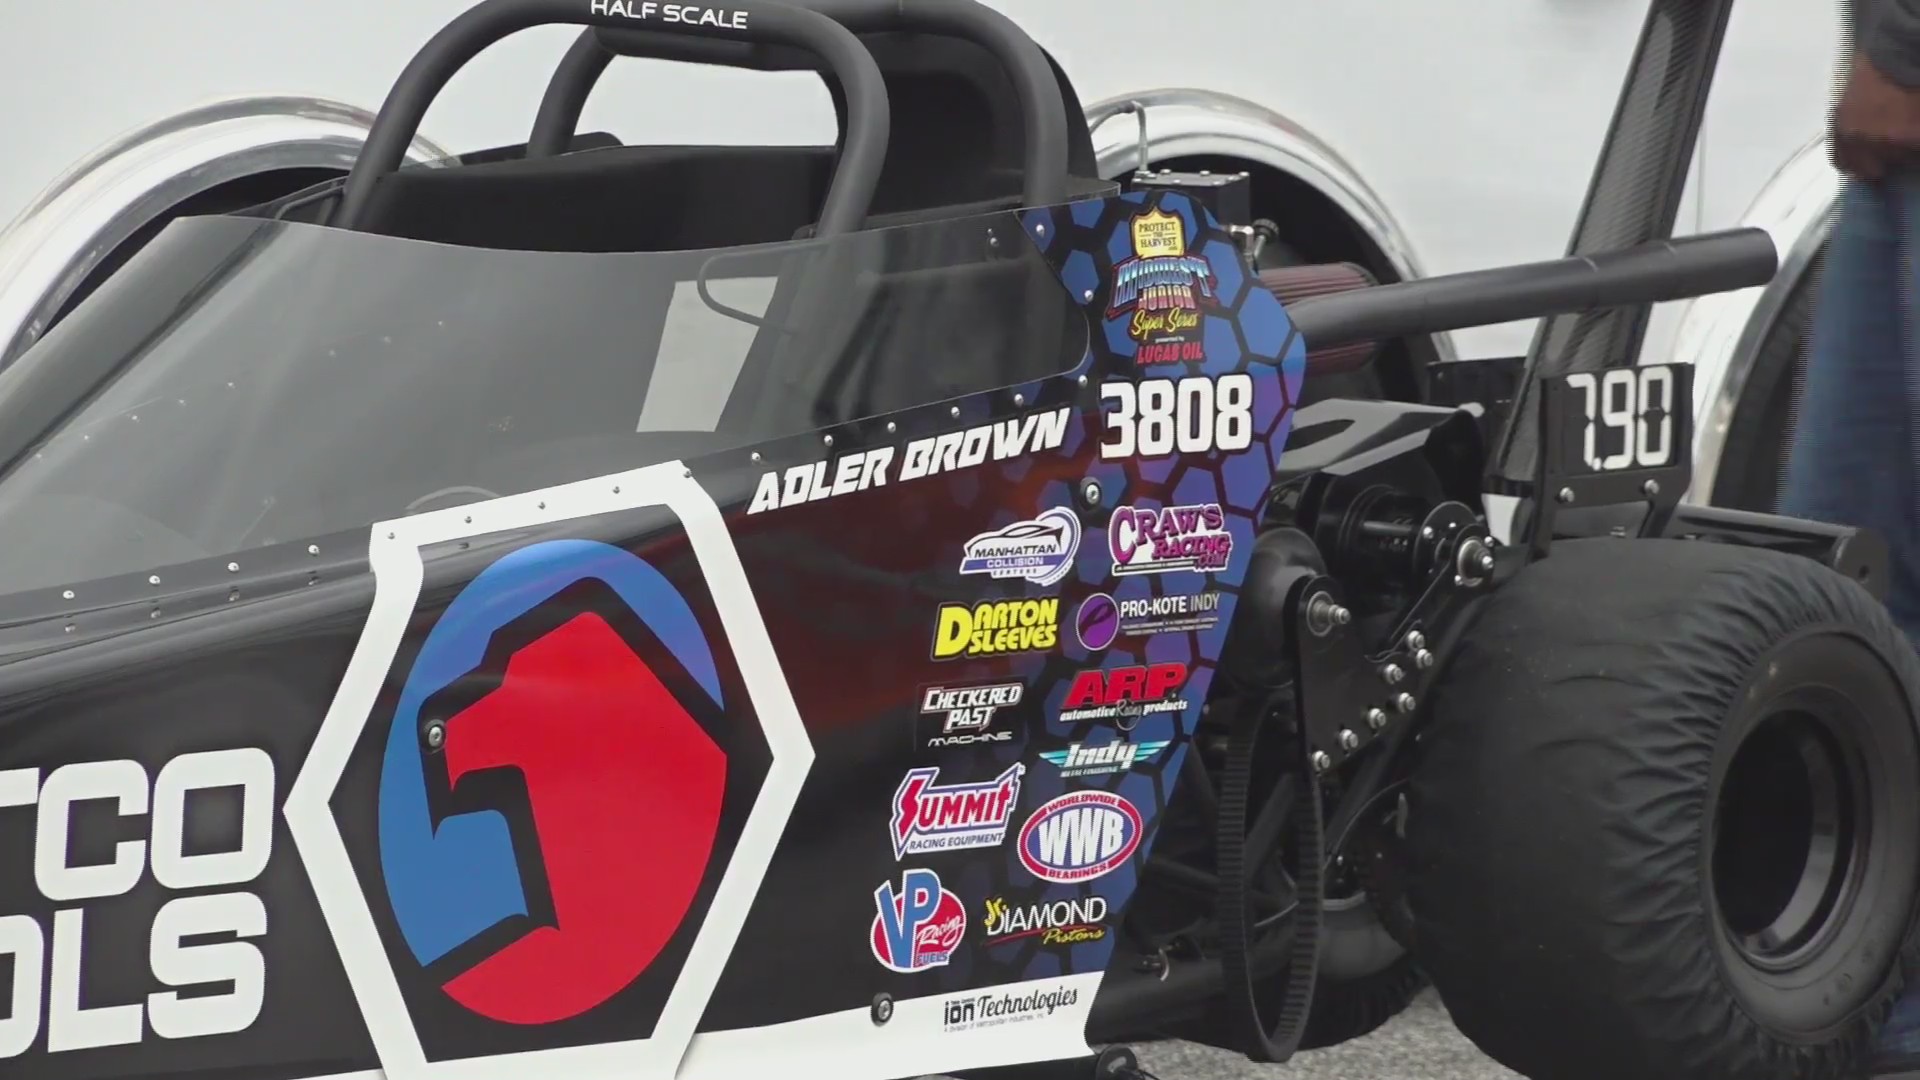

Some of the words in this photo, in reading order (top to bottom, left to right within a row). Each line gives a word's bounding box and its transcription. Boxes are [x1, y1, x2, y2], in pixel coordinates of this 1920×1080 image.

[591, 0, 657, 19] HALF
[663, 5, 748, 29] SCALE
[1138, 221, 1176, 233] PROTECT
[1140, 237, 1177, 248] HARVEST
[1114, 257, 1210, 307] MIDWEST
[1138, 285, 1196, 310] JUNIOR
[1131, 309, 1164, 340] Super
[1166, 307, 1198, 333] Series
[1137, 344, 1180, 364] LUCAS
[1182, 342, 1203, 360] OIL
[1100, 373, 1253, 458] 3808
[747, 445, 894, 515] ADLER
[899, 407, 1071, 482] BROWN
[1110, 506, 1222, 565] CRAW'S
[1152, 533, 1231, 560] RACING
[975, 544, 1057, 558] MANHATTAN
[986, 556, 1044, 568] COLLISION
[1120, 596, 1187, 618] PRO-KOTE
[1190, 593, 1220, 612] INDY
[934, 599, 1059, 656] DARTON
[968, 624, 1057, 654] SLEEVES
[922, 685, 1022, 711] CHECKERED
[1061, 662, 1187, 709] ARP
[946, 706, 995, 731] PAST
[1060, 705, 1116, 722] automotive
[1142, 699, 1188, 716] products
[928, 731, 1012, 747] MACHINE
[1064, 740, 1138, 769] Indy
[899, 775, 1012, 840] SUMMIT
[1048, 794, 1120, 812] WORLDWIDE
[909, 838, 946, 850] RACING
[948, 833, 1004, 847] EQUIPMENT
[1038, 807, 1124, 866] WWB
[874, 868, 942, 969] VP
[987, 896, 1107, 936] DIAMOND
[916, 916, 964, 947] Racing
[1042, 928, 1105, 945] Pistons
[916, 951, 948, 966] FUELS
[944, 1001, 975, 1025] ion
[977, 985, 1077, 1018] Technologies
